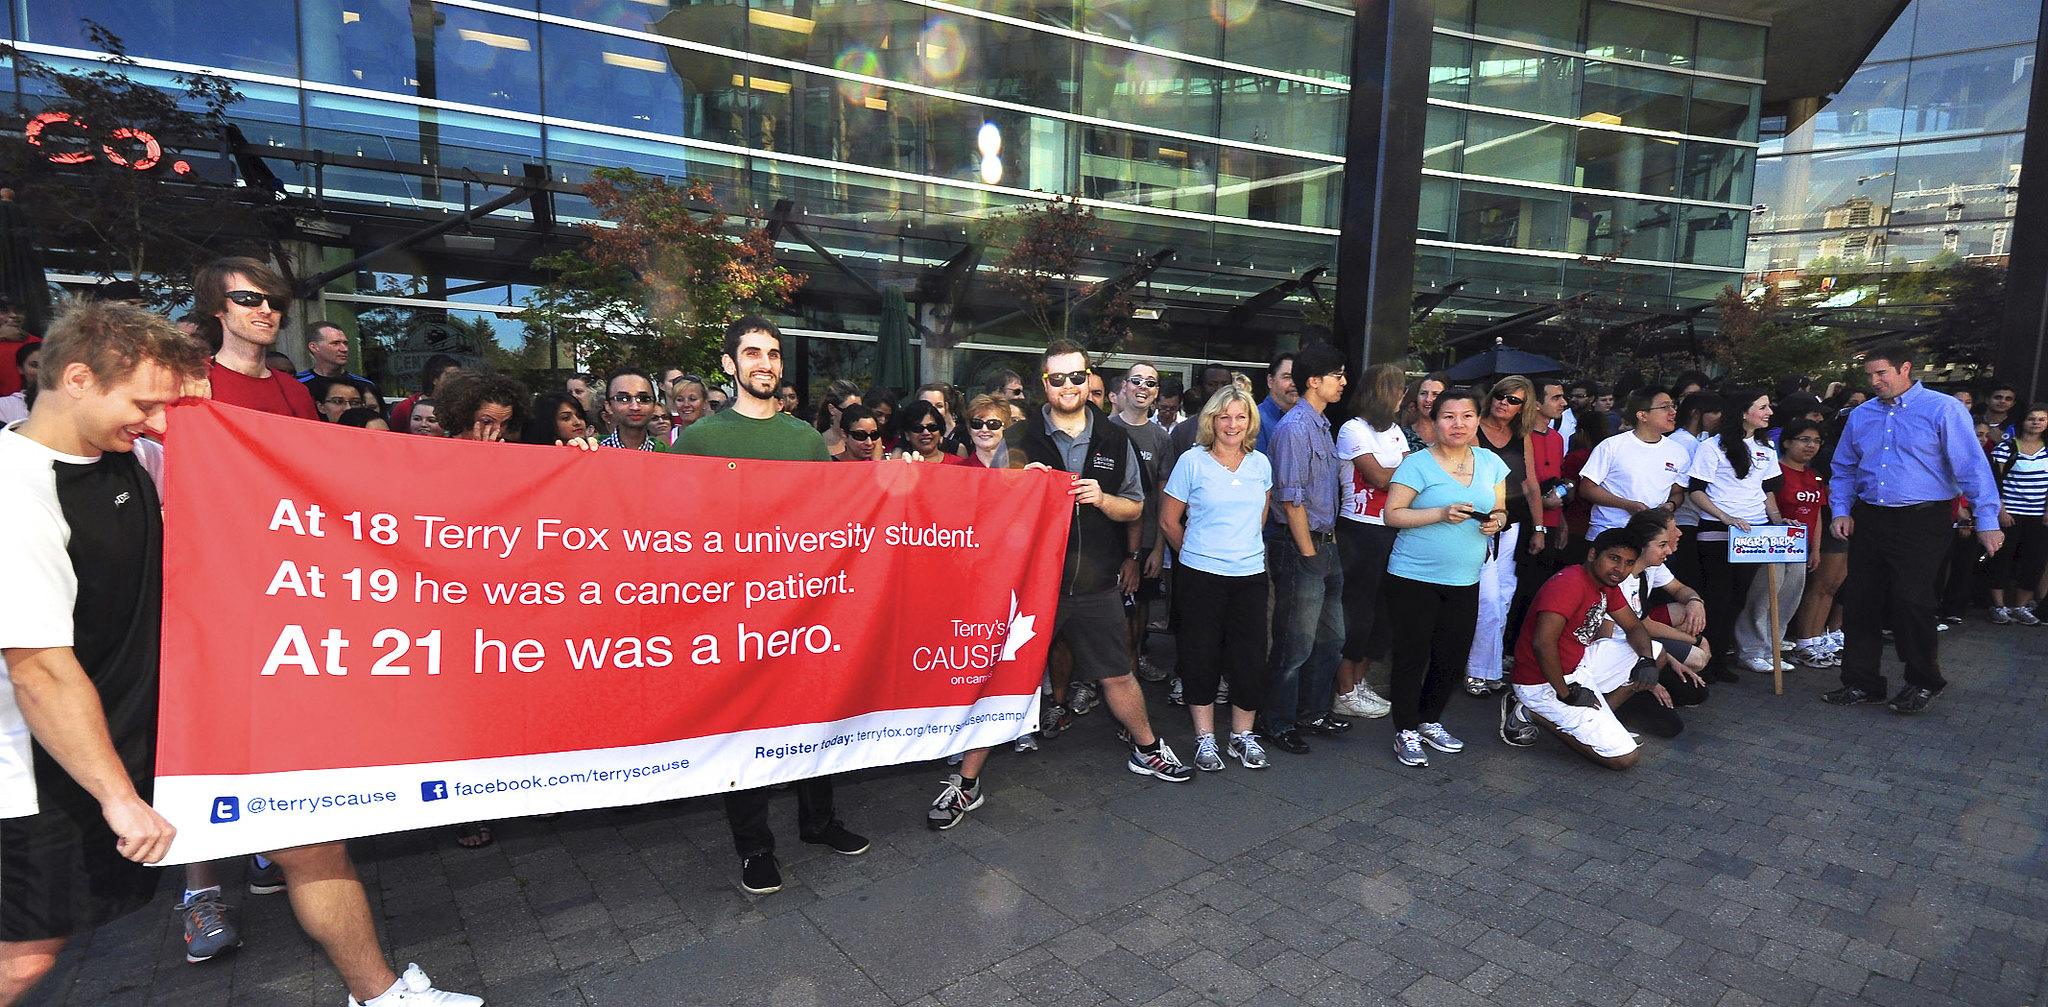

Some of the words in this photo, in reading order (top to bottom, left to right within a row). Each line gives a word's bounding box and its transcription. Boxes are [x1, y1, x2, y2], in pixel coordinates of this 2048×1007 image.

[268, 498, 326, 538] At
[343, 511, 399, 545] 18
[414, 515, 522, 559] Terry
[537, 518, 610, 551] Fox
[622, 529, 693, 553] was
[703, 531, 724, 553] a
[734, 522, 876, 553] university
[885, 521, 980, 548] student.
[1733, 536, 1767, 548] ANGRY
[1769, 535, 1797, 547] BIRDS
[264, 560, 326, 598] At
[342, 567, 398, 603] 19
[415, 571, 468, 604] he
[482, 581, 565, 605] was
[578, 581, 603, 605] a
[615, 581, 735, 605] cancer
[745, 569, 855, 609] patient.
[950, 619, 1006, 640] Terry's
[260, 624, 350, 676] At
[370, 628, 441, 676] 21
[474, 628, 546, 674] he
[564, 636, 673, 670] was
[691, 634, 721, 665] a
[738, 622, 841, 662] hero.
[912, 643, 1002, 671] CAUSE
[950, 676, 965, 685] on
[755, 741, 818, 760] Register
[820, 732, 854, 750] today:
[454, 758, 691, 797] facebook.com/terryscause
[246, 790, 397, 814] @terryscause
